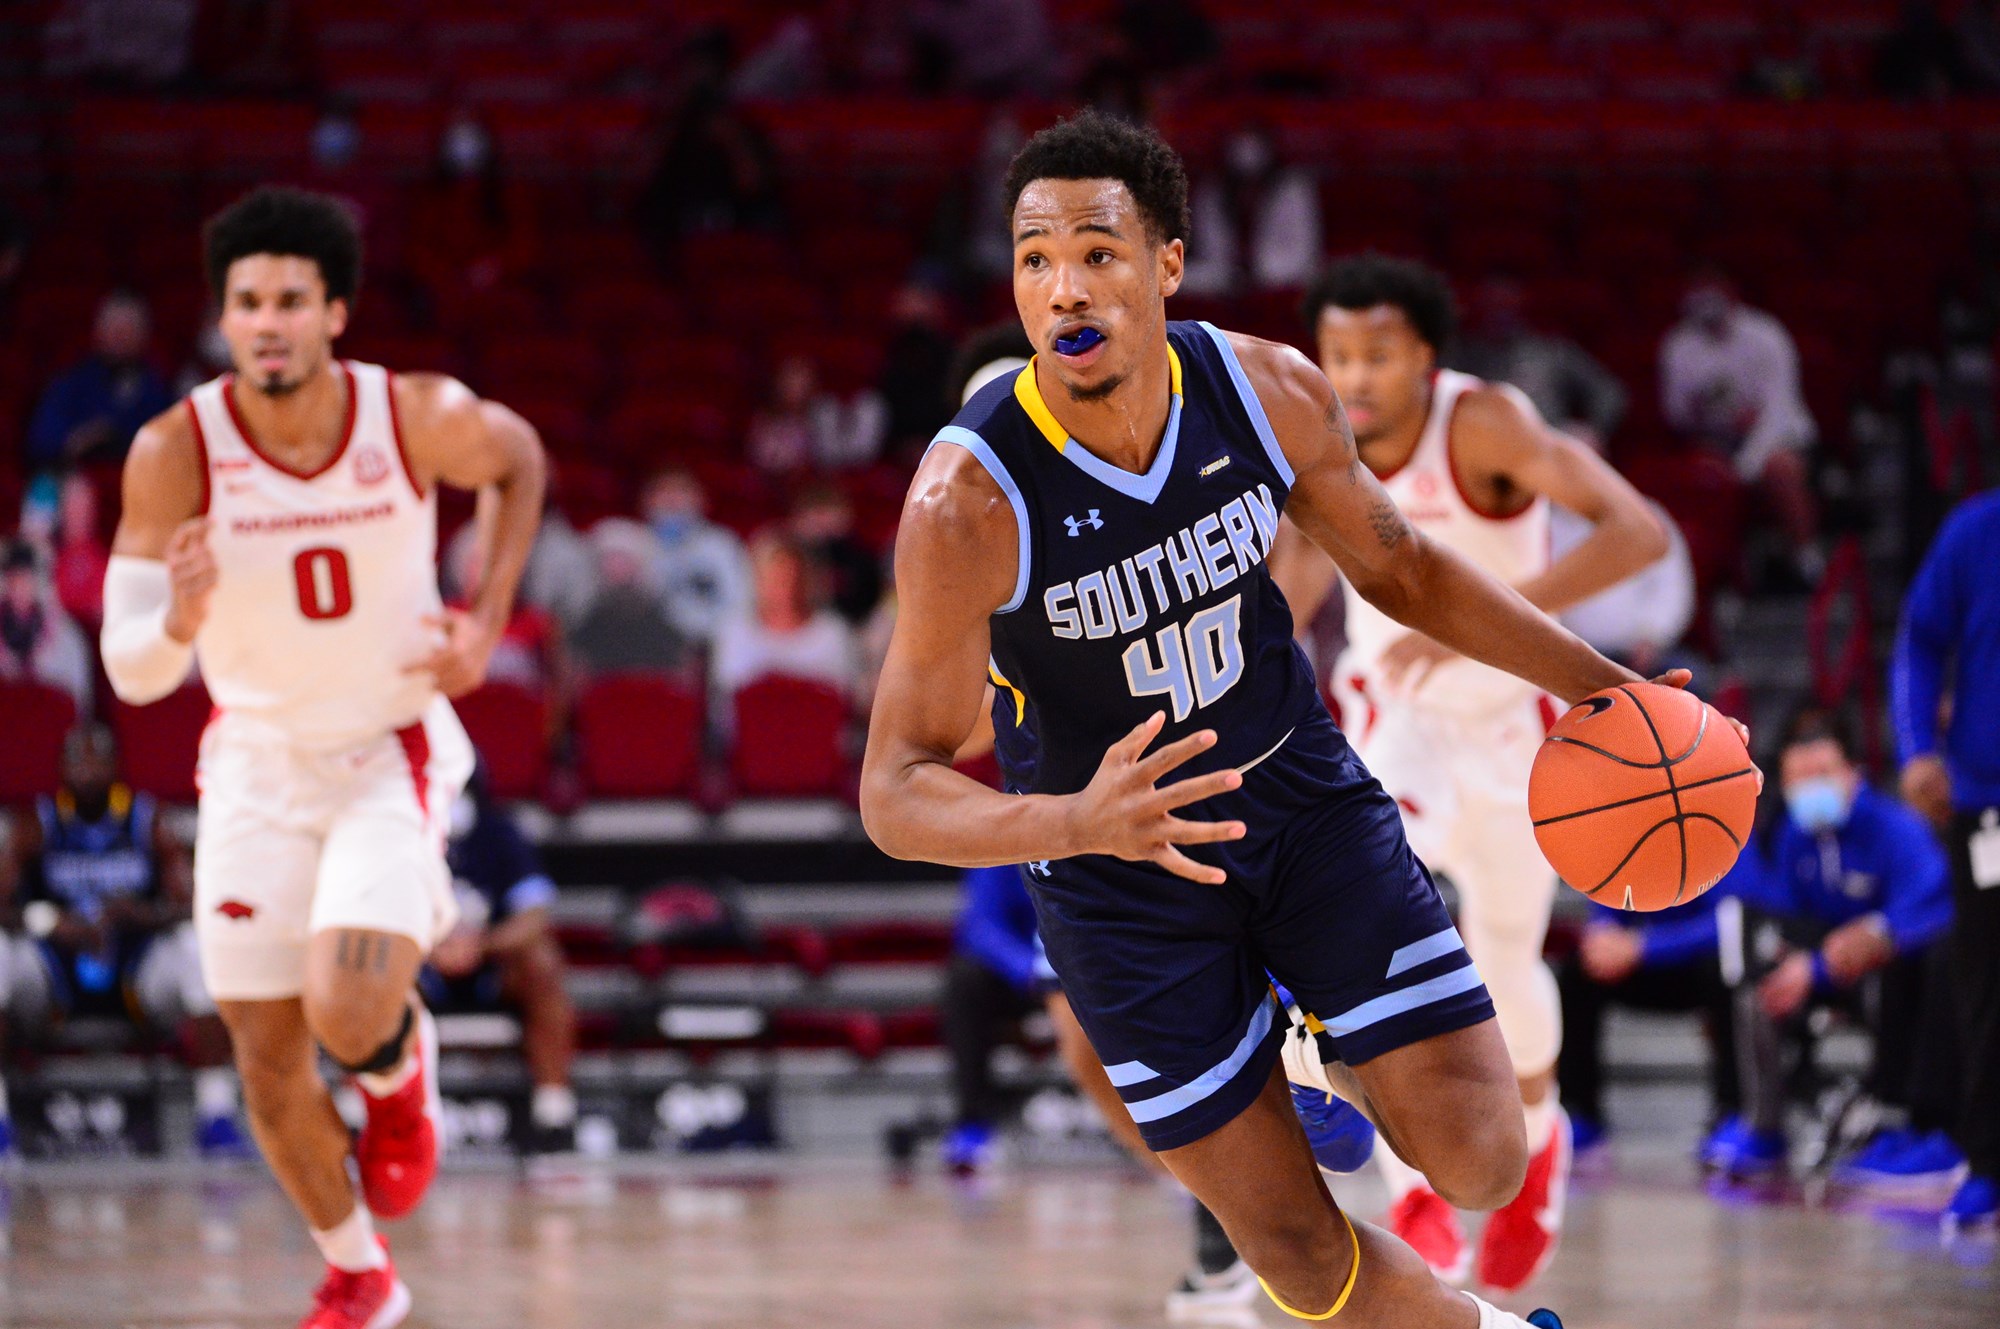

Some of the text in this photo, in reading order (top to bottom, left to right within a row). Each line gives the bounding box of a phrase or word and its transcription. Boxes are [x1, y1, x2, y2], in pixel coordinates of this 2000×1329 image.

[294, 546, 354, 621] 0
[1043, 483, 1279, 640] SOUTHERN
[1121, 593, 1245, 723] 40
